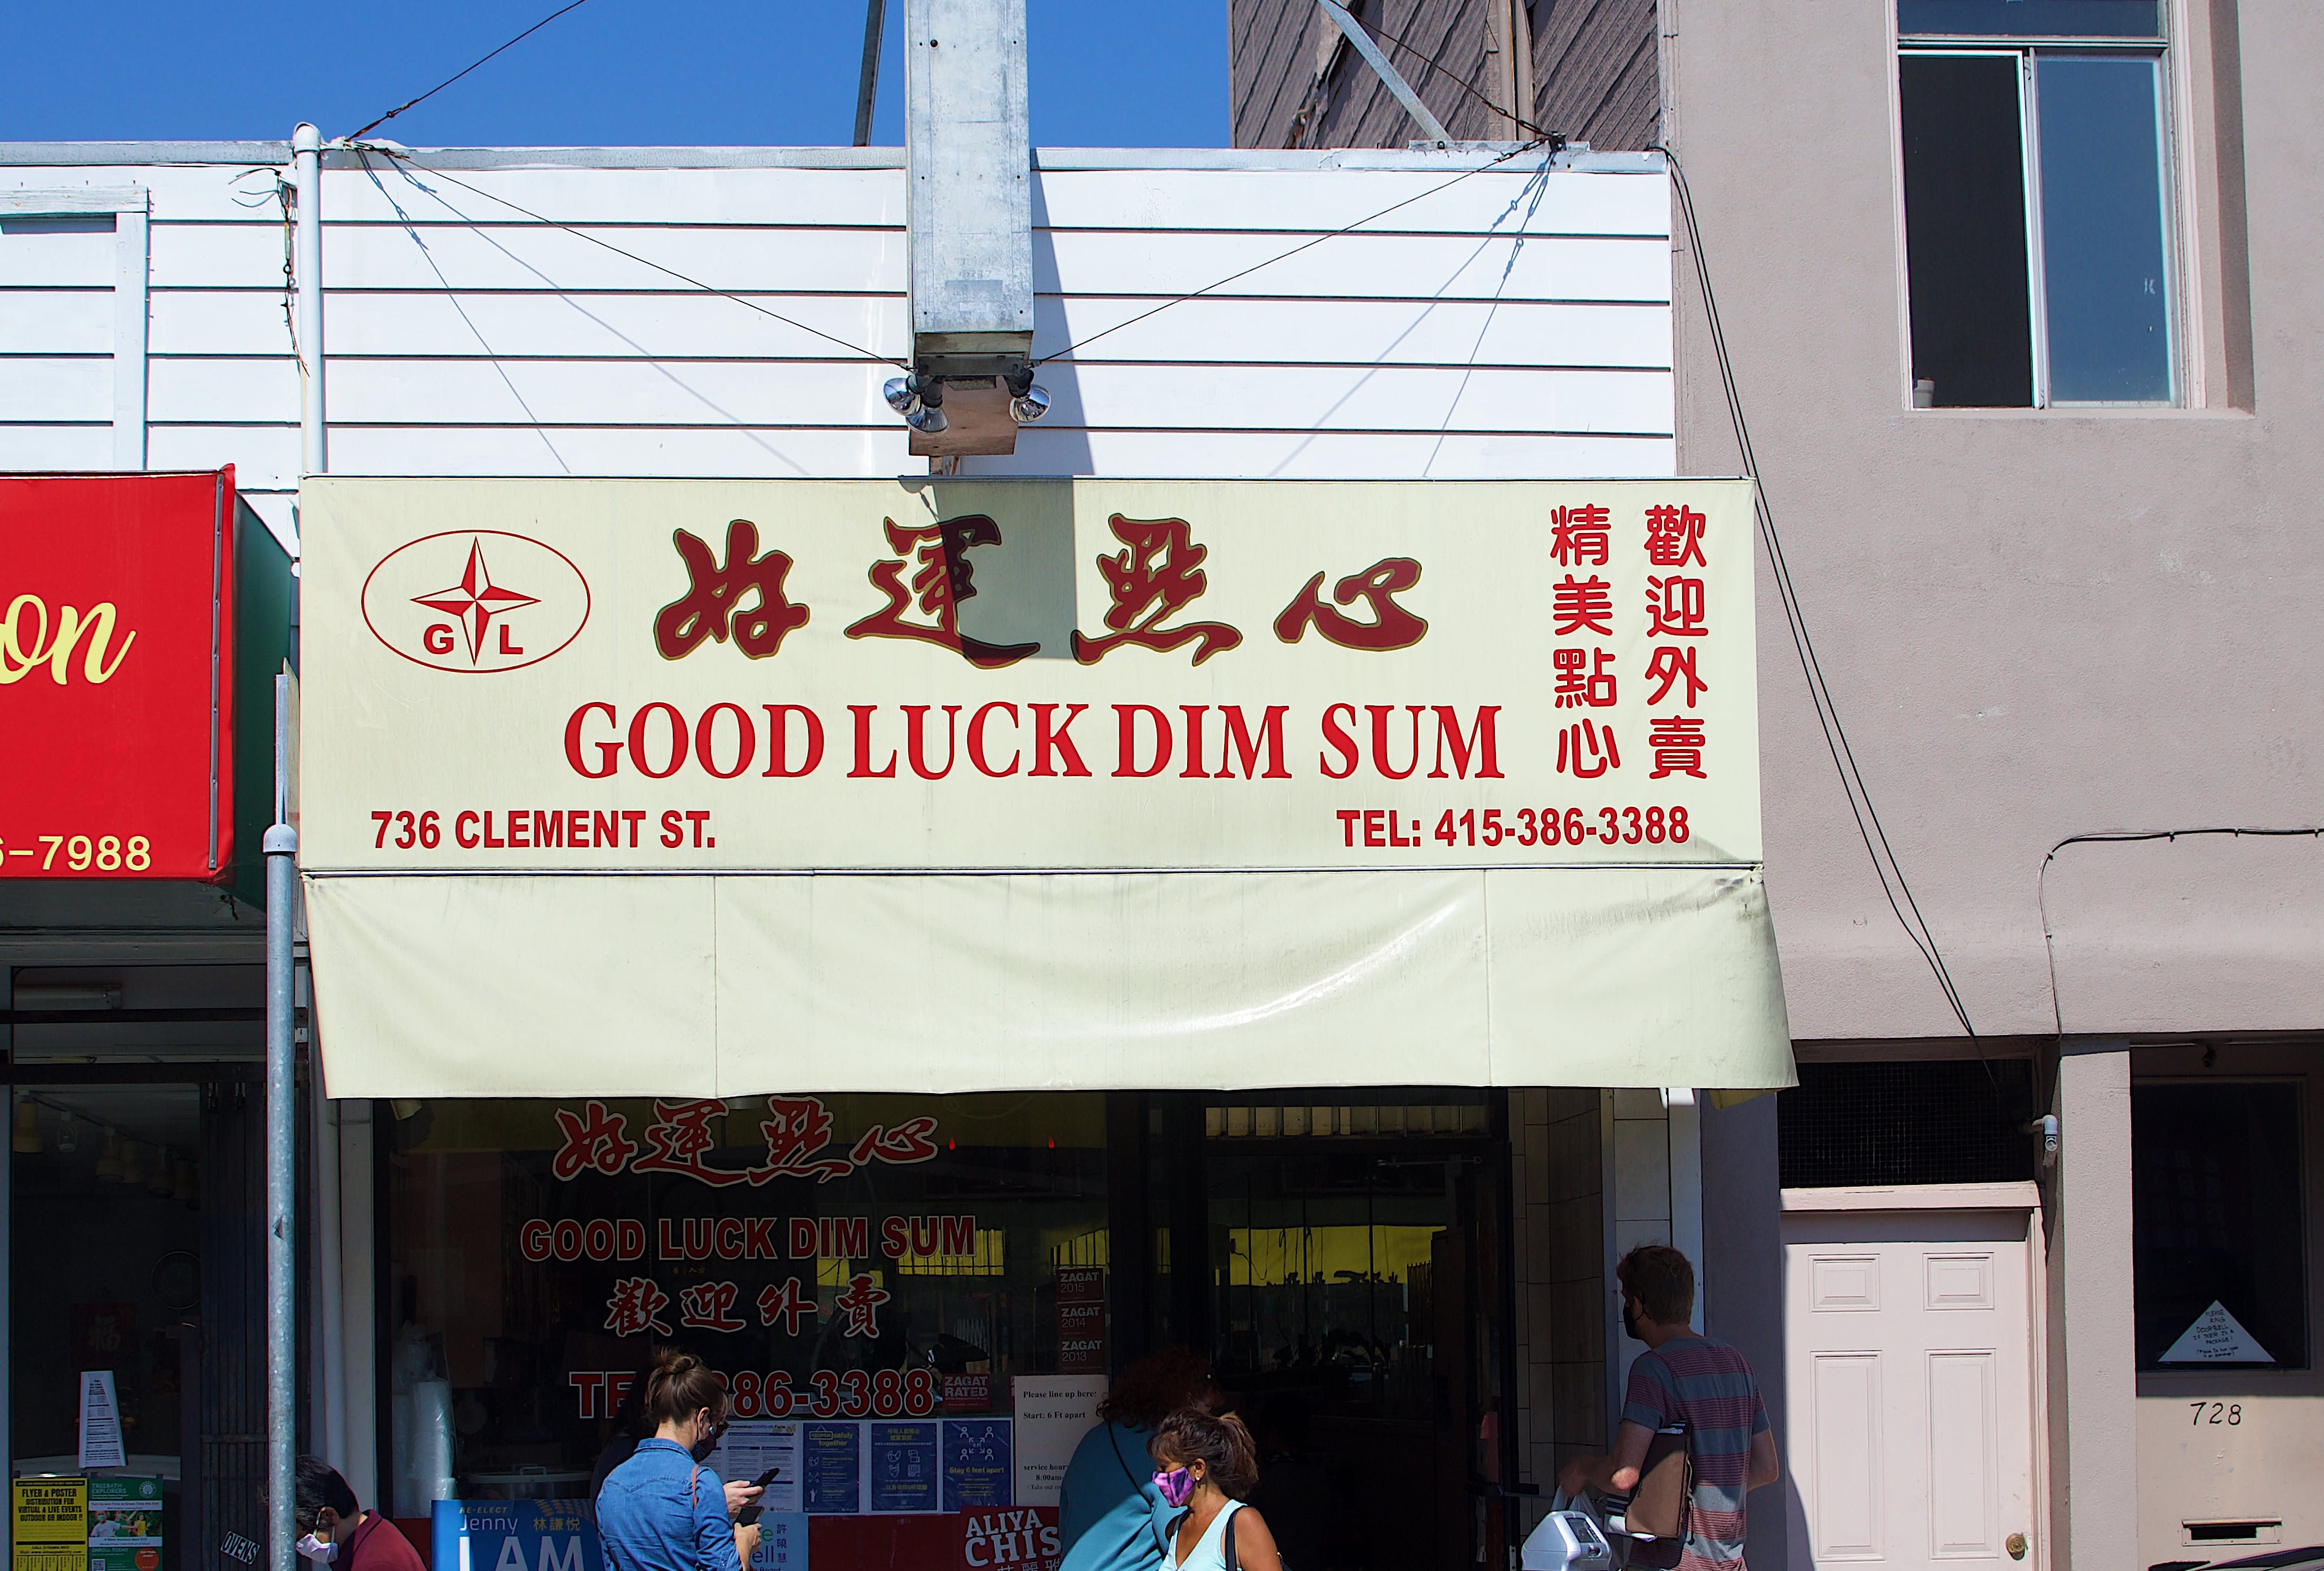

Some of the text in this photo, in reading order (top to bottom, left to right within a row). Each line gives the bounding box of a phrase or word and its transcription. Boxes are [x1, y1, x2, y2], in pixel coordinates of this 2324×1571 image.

[0, 594, 136, 685] on
[423, 623, 524, 655] G L
[1550, 503, 1620, 779] 精美點心
[1644, 504, 1708, 780] 歡迎外賣
[565, 701, 1505, 781] GOOD LUCK DIM SUM
[371, 810, 716, 849] 736 CLEMENT ST.
[1336, 806, 1689, 847] TEL: 415-386-3388
[520, 1215, 976, 1262] GOOD LUCK DIM SUM
[1060, 1272, 1099, 1283] ZAGAT
[1061, 1282, 1085, 1293] 2015
[603, 1272, 891, 1339] 歡迎外賣
[1061, 1306, 1101, 1317] ZAGAT
[1062, 1317, 1086, 1328] 2014
[1062, 1340, 1103, 1351] ZAGAT
[1062, 1351, 1087, 1362] 2013
[568, 1368, 935, 1419] TE 86-3388
[945, 1375, 988, 1387] ZAGAT
[945, 1387, 988, 1398] RATED
[1065, 1392, 1075, 1400] up
[2190, 1402, 2242, 1426] 728
[22, 1489, 42, 1497] FLYER
[51, 1488, 77, 1497] POSTER
[460, 1514, 518, 1535] Jenny
[965, 1509, 1043, 1538] ALIYA
[222, 1532, 258, 1563] OVENS
[965, 1526, 1063, 1568] CHIS
